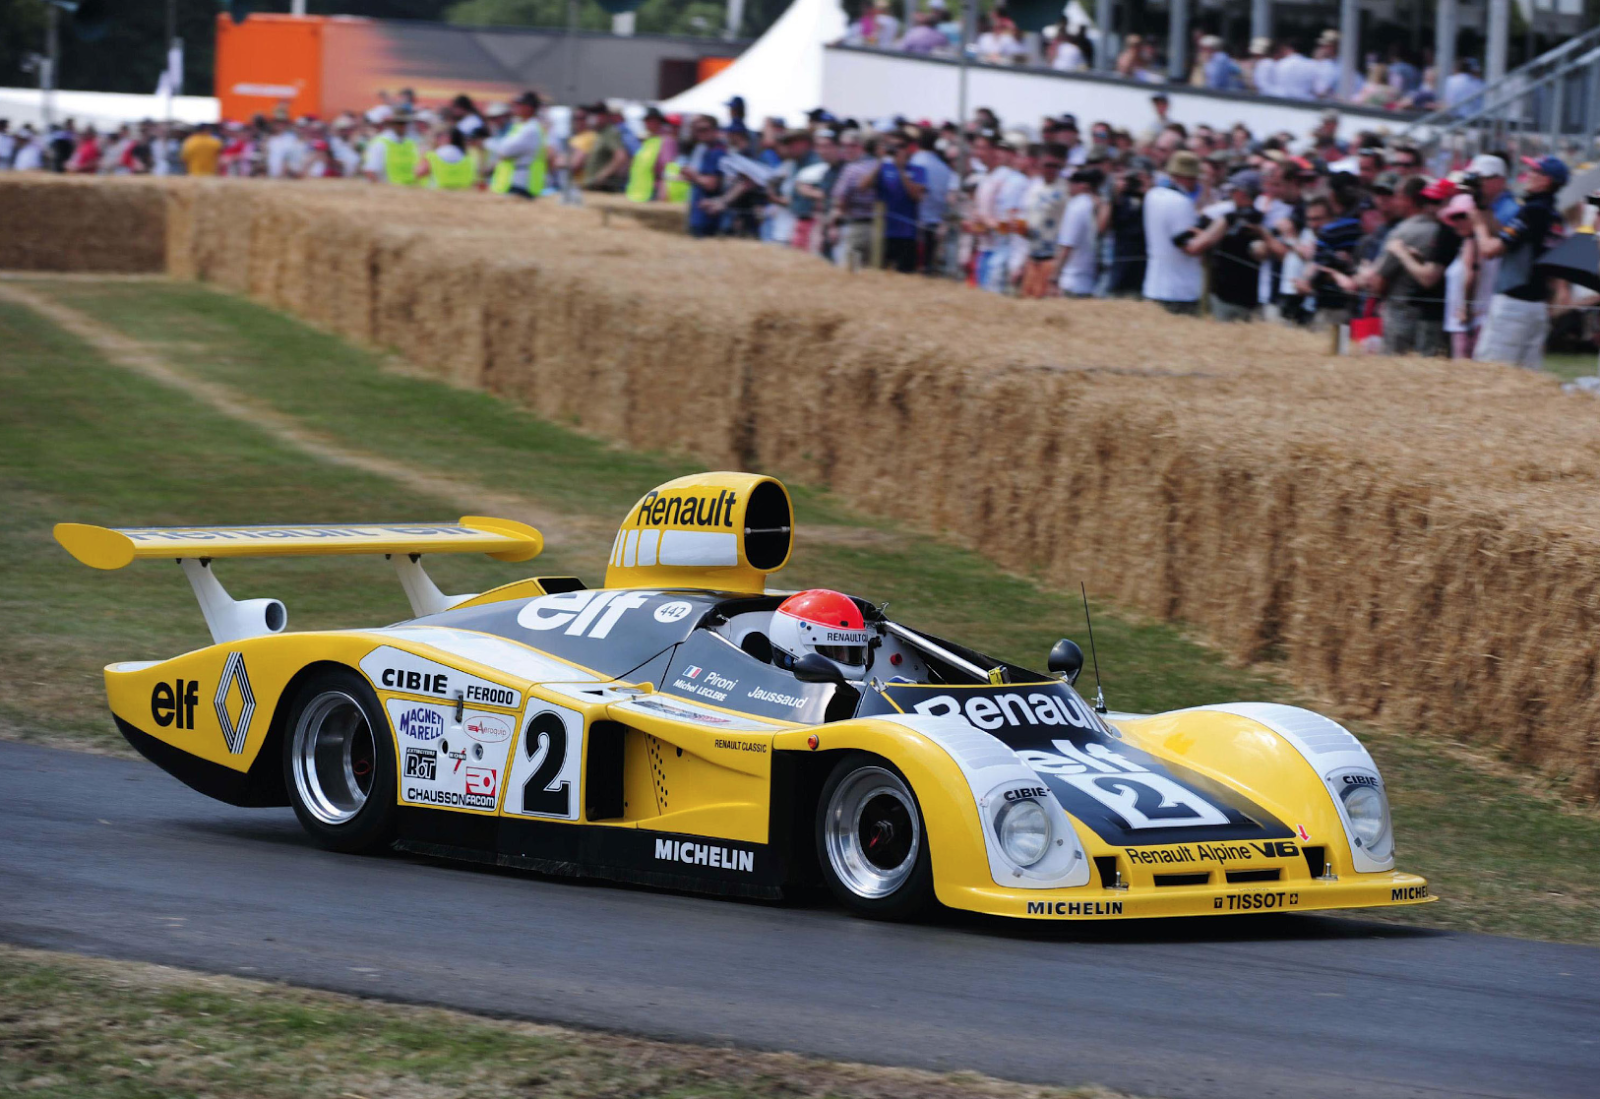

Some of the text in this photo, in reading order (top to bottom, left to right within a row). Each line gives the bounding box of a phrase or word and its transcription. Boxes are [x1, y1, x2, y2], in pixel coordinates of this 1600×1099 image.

[637, 490, 736, 527] Renault
[517, 590, 656, 639] elf
[660, 605, 686, 618] 442
[827, 632, 861, 643] RENAULT
[672, 679, 728, 702] Michel LECLERE
[703, 671, 739, 691] Pironi
[151, 678, 199, 730] elf
[466, 685, 514, 705] FERODO
[747, 686, 808, 709] Jaussaud
[478, 721, 507, 737] Aeroquip
[714, 738, 767, 753] RENAULT CLASSIC
[1015, 739, 1150, 774] elf
[521, 709, 571, 817] 2
[407, 787, 466, 806] CHAUSSON
[1095, 776, 1204, 820] 2
[654, 838, 755, 873] MICHELIN
[1124, 841, 1300, 865] Renault Alpine V6
[1026, 901, 1123, 915] MICHELIN
[1226, 892, 1286, 910] TISSOT
